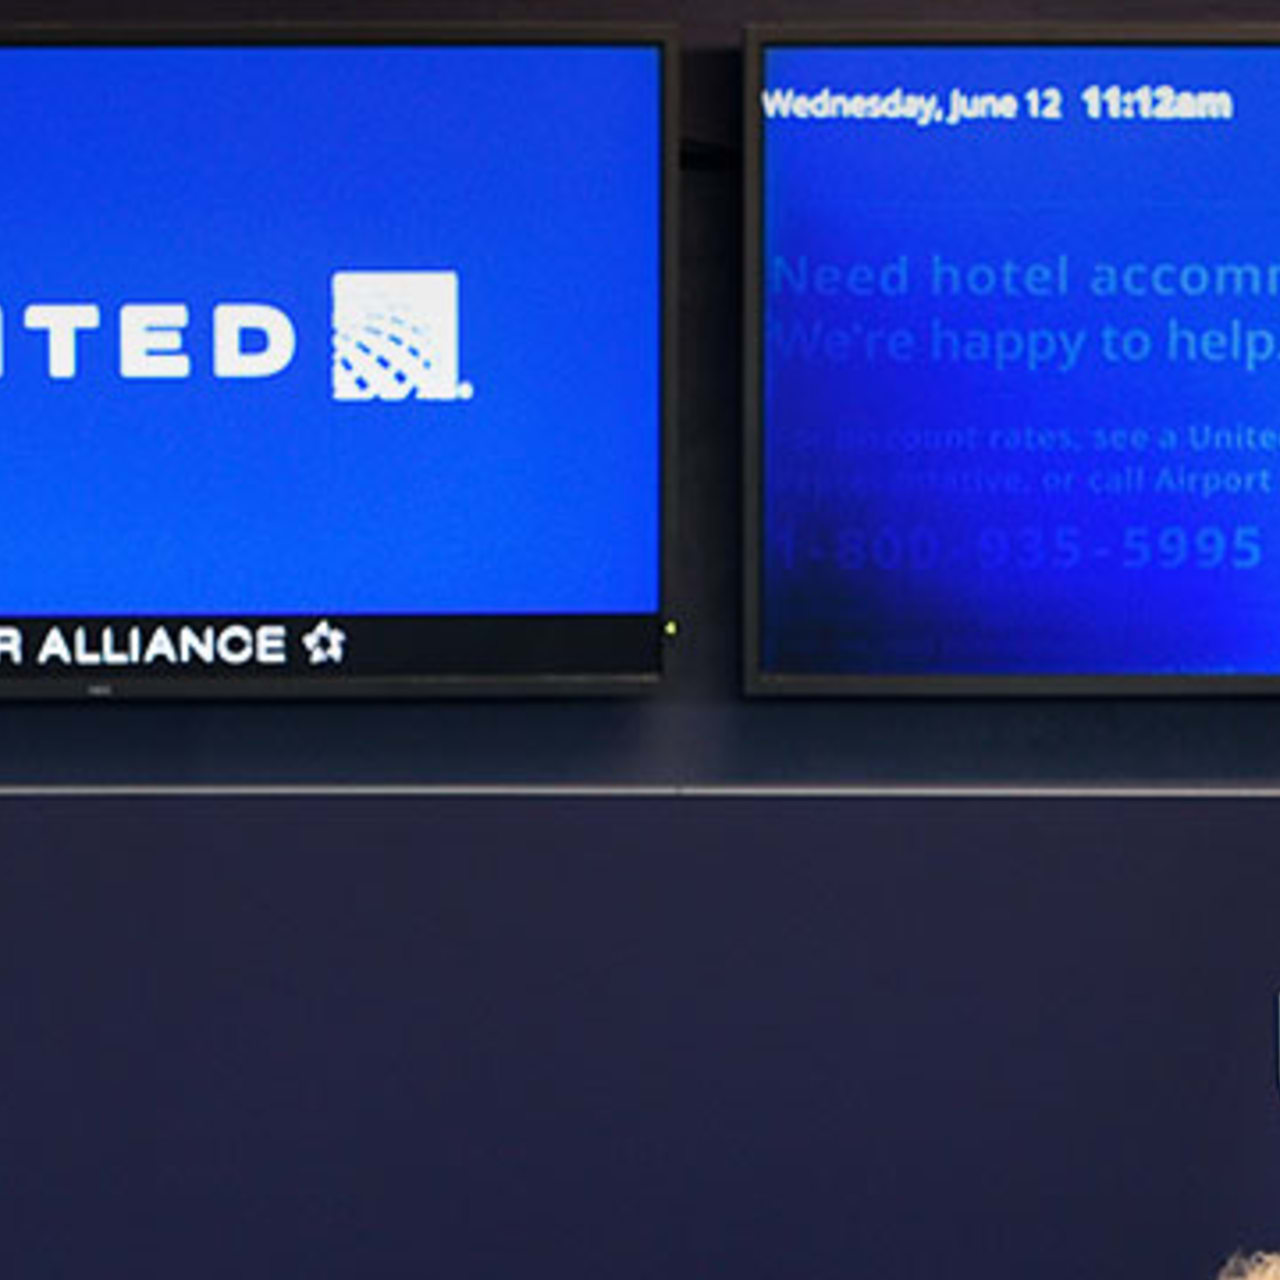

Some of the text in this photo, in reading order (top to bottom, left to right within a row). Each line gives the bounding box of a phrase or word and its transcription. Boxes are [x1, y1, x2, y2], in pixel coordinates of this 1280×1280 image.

[763, 85, 1233, 126] Wednesday, June 12 11:12am
[772, 254, 908, 297] Need
[932, 254, 1069, 297] hotel
[932, 317, 1085, 371] happy
[1100, 325, 1152, 362] to
[1094, 433, 1152, 451] see
[1157, 433, 1177, 451] a
[1154, 466, 1270, 499] Airport
[38, 624, 286, 665] ALLIANCE
